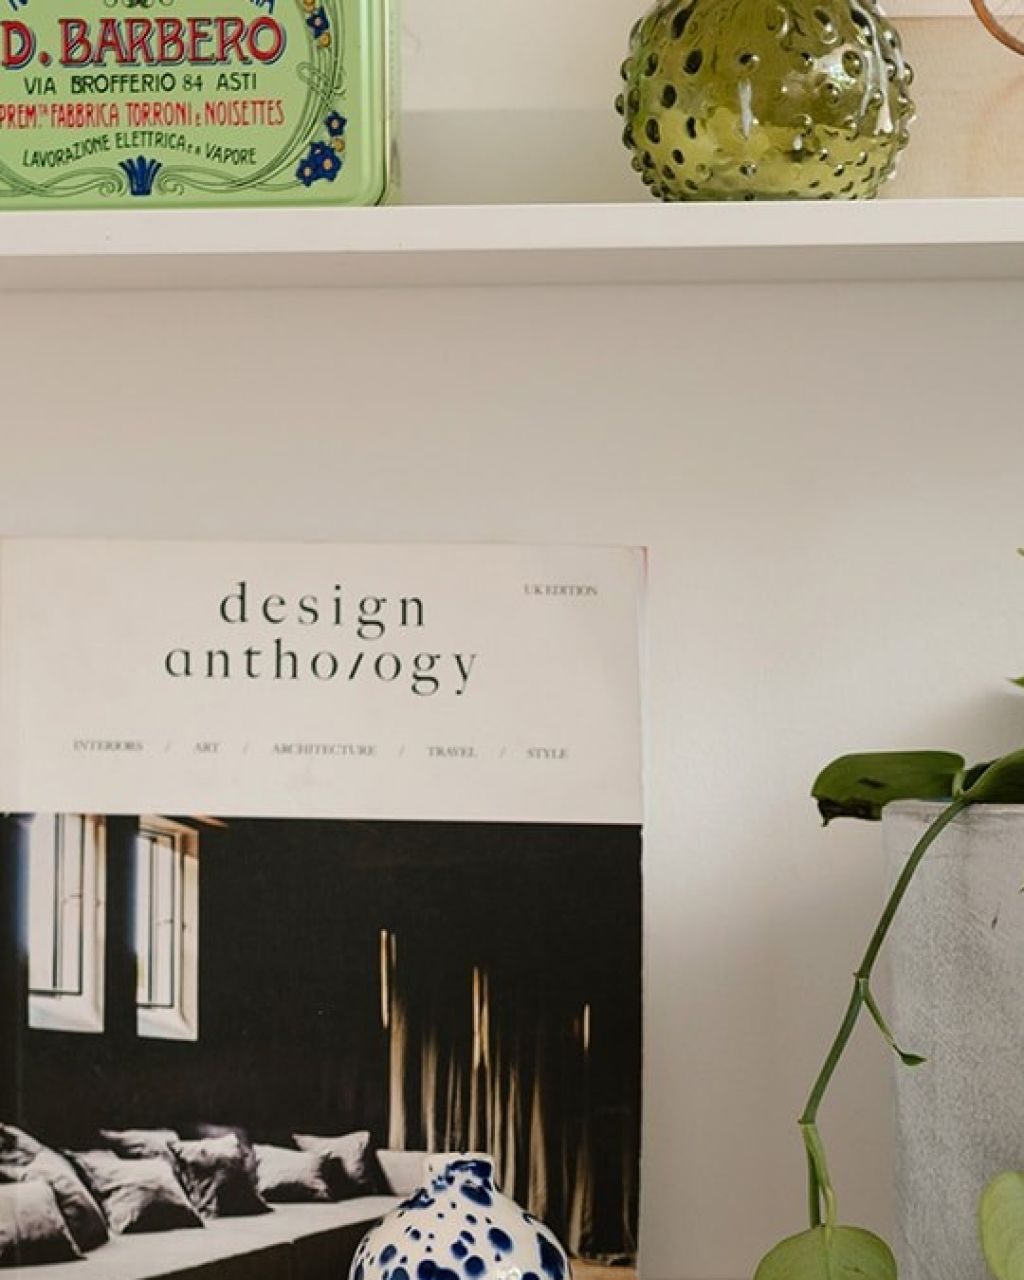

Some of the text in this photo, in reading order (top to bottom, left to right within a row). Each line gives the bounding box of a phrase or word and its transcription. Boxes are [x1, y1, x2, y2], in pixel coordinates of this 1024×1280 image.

[0, 16, 287, 69] D. BARBERO
[24, 71, 257, 95] VIA BROFFERIO 84 ASTI
[51, 102, 120, 128] FABBRICA
[126, 101, 192, 127] TORRONI
[205, 99, 285, 127] NOISETTES
[22, 133, 110, 167] LAVORAZIONE
[115, 130, 186, 152] ELETTRICA
[206, 142, 257, 166] VAPORE
[545, 583, 599, 597] EDITION
[219, 581, 425, 641] design
[73, 739, 569, 760] INTERIORS ART ARCHITECTURE TRAVEL STYLE
